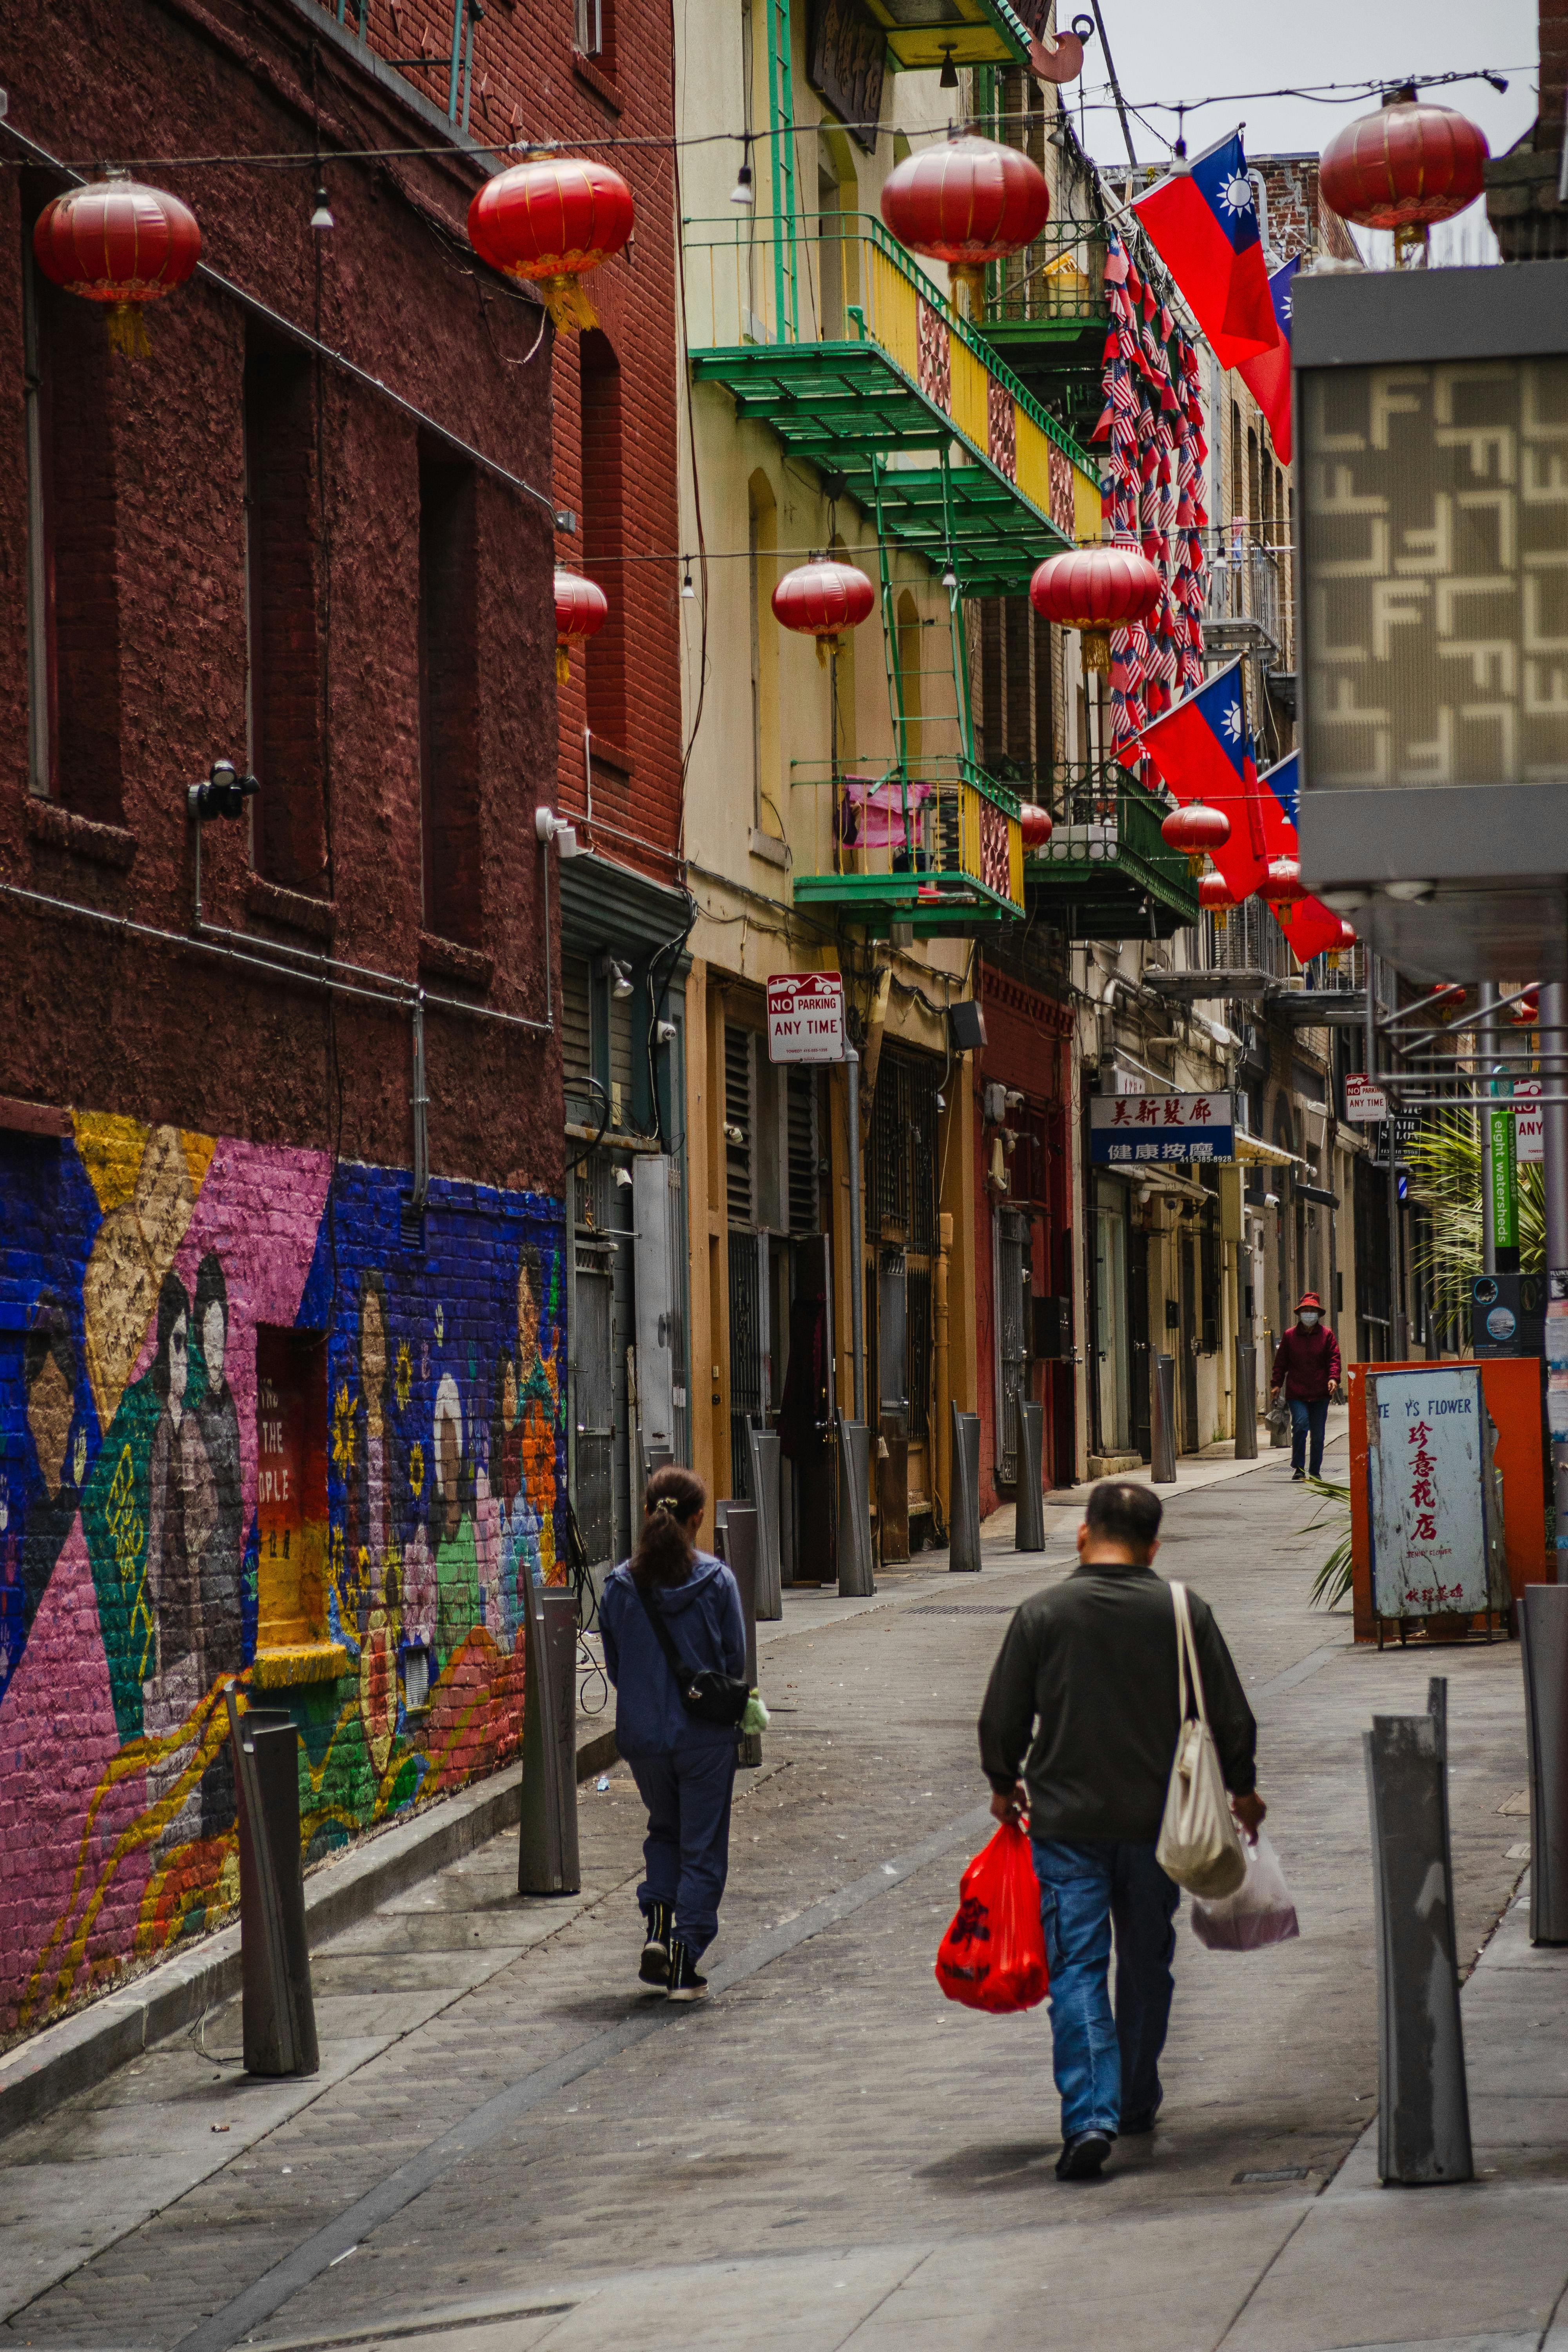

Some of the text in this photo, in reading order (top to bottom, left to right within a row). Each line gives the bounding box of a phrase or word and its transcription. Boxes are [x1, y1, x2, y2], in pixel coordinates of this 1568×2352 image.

[771, 998, 836, 1011] NO PARKING
[775, 1020, 838, 1036] ANY TIME
[1350, 1098, 1384, 1108] ANY TIME
[1110, 1098, 1212, 1126] 美新髮廊
[1518, 1122, 1543, 1136] ANY
[1108, 1142, 1214, 1160] 健康按摩
[1493, 1120, 1508, 1243] eight watersheds
[1428, 1398, 1472, 1415] FLOWER
[262, 1421, 283, 1454] THE
[1408, 1421, 1437, 1541] 珍意花店
[1430, 1548, 1452, 1556] FLOWER
